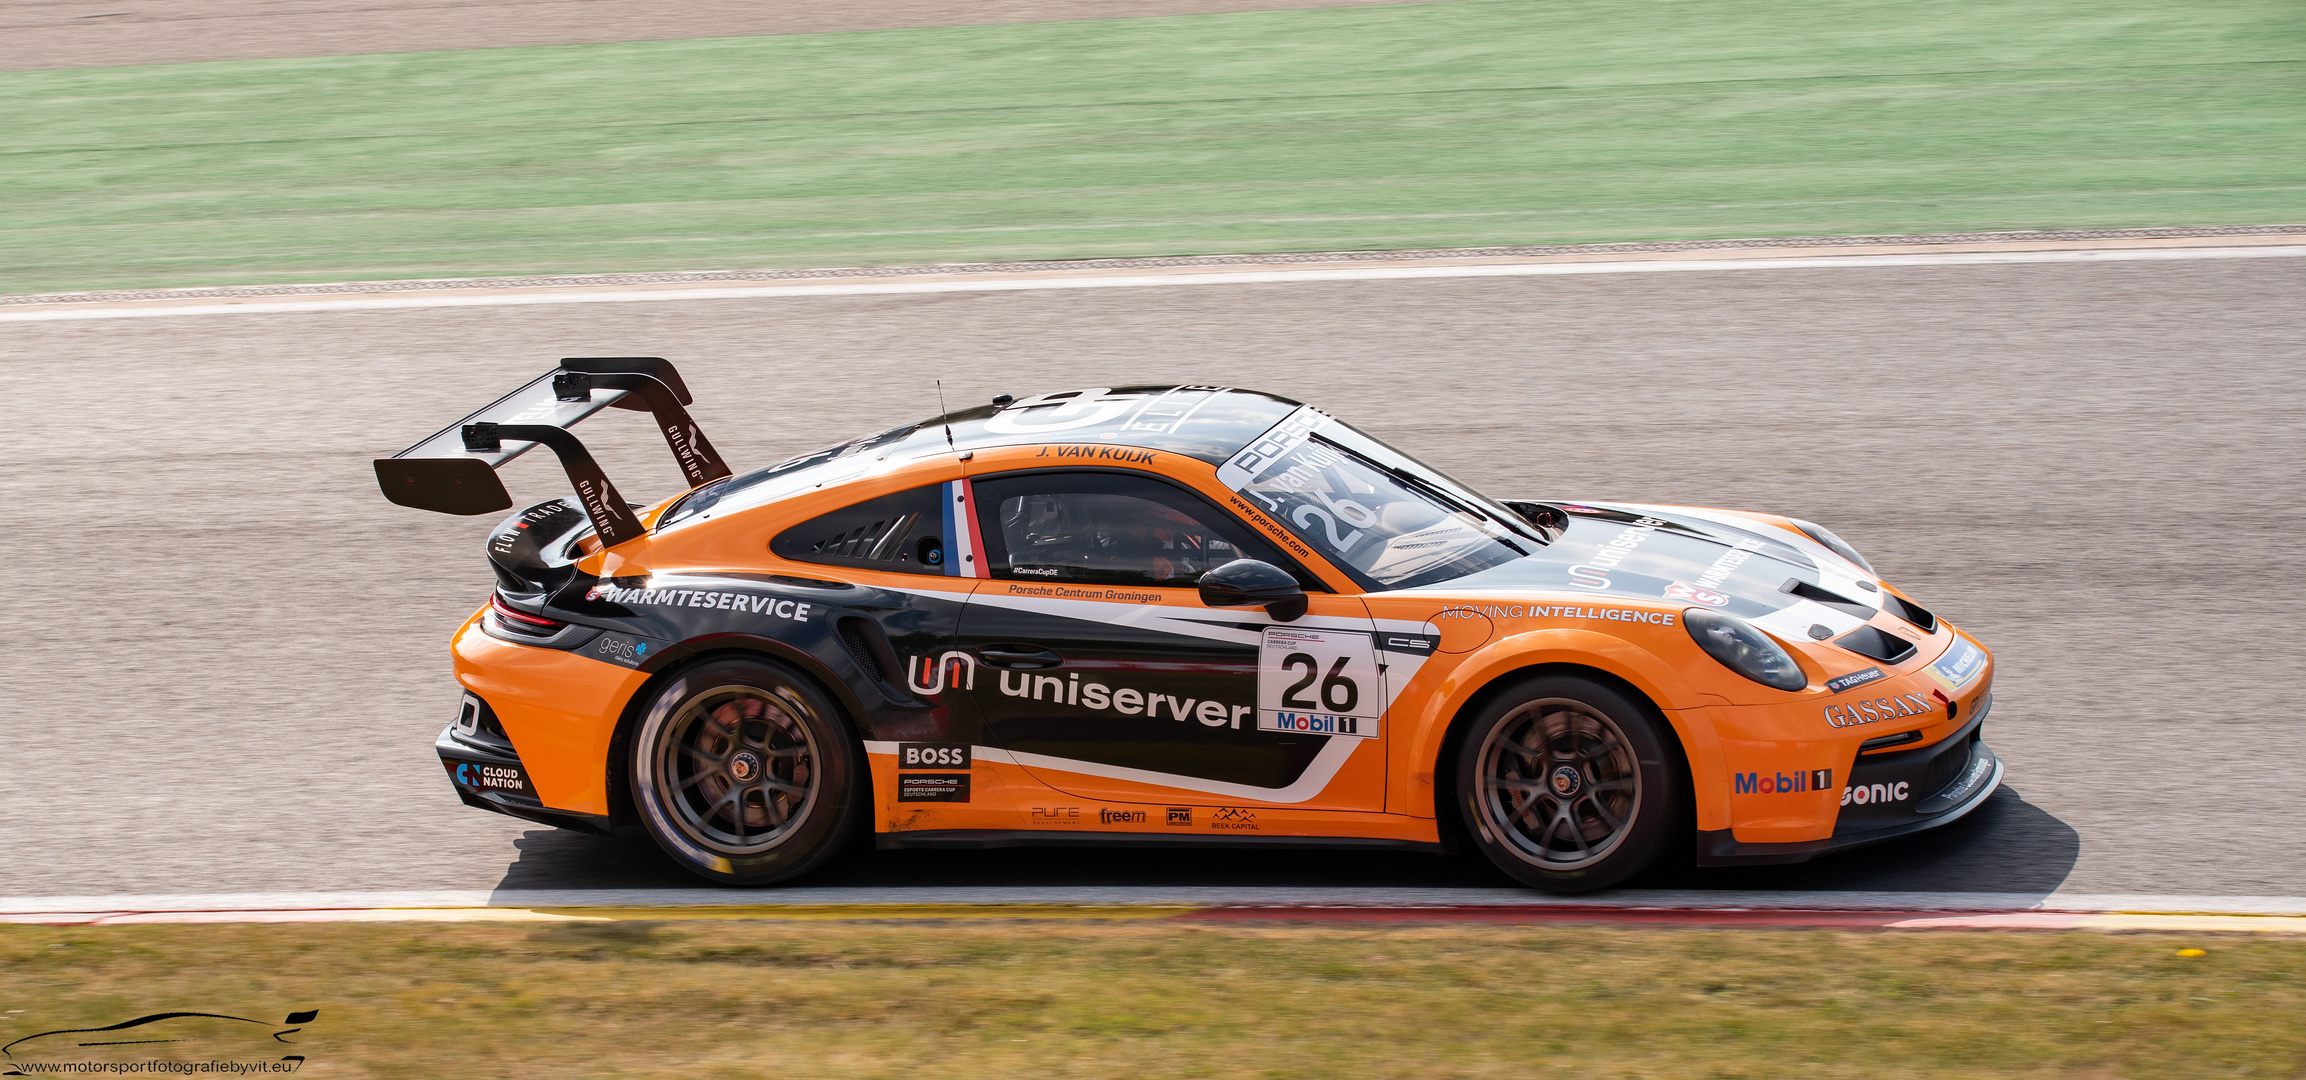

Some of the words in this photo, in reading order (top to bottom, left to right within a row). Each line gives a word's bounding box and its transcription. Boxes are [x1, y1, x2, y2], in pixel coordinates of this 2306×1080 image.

[668, 425, 701, 478] GULLWING
[1036, 446, 1050, 458] J.
[1057, 445, 1096, 458] VAN
[1098, 447, 1158, 465] KUIJK
[1249, 489, 1285, 512] J.
[1269, 466, 1314, 494] van
[579, 480, 612, 537] GULLWING
[1229, 495, 1310, 559] www.porsche.com
[1292, 488, 1378, 553] 26
[494, 527, 521, 554] FLOW
[1013, 567, 1058, 576] #CarreraCupDE
[605, 588, 811, 622] WARMTESERVICE
[1008, 584, 1053, 596] Porsche
[1055, 587, 1103, 599] Centrum
[1105, 589, 1162, 603] Groningen
[1441, 605, 1523, 620] MOVING
[1528, 605, 1676, 626] INTELLIGENCE
[599, 637, 635, 658] geris
[1952, 645, 1977, 675] MICHELIN
[1281, 652, 1358, 713] 26
[999, 669, 1251, 730] uniserver
[1824, 692, 1933, 729] GASSAN
[1277, 712, 1334, 732] Mobil
[906, 747, 963, 765] BOSS
[483, 766, 518, 779] CLOUD
[483, 777, 523, 790] NATION
[1735, 771, 1806, 794] Mobil
[1100, 807, 1146, 824] freem
[1168, 812, 1190, 821] PM
